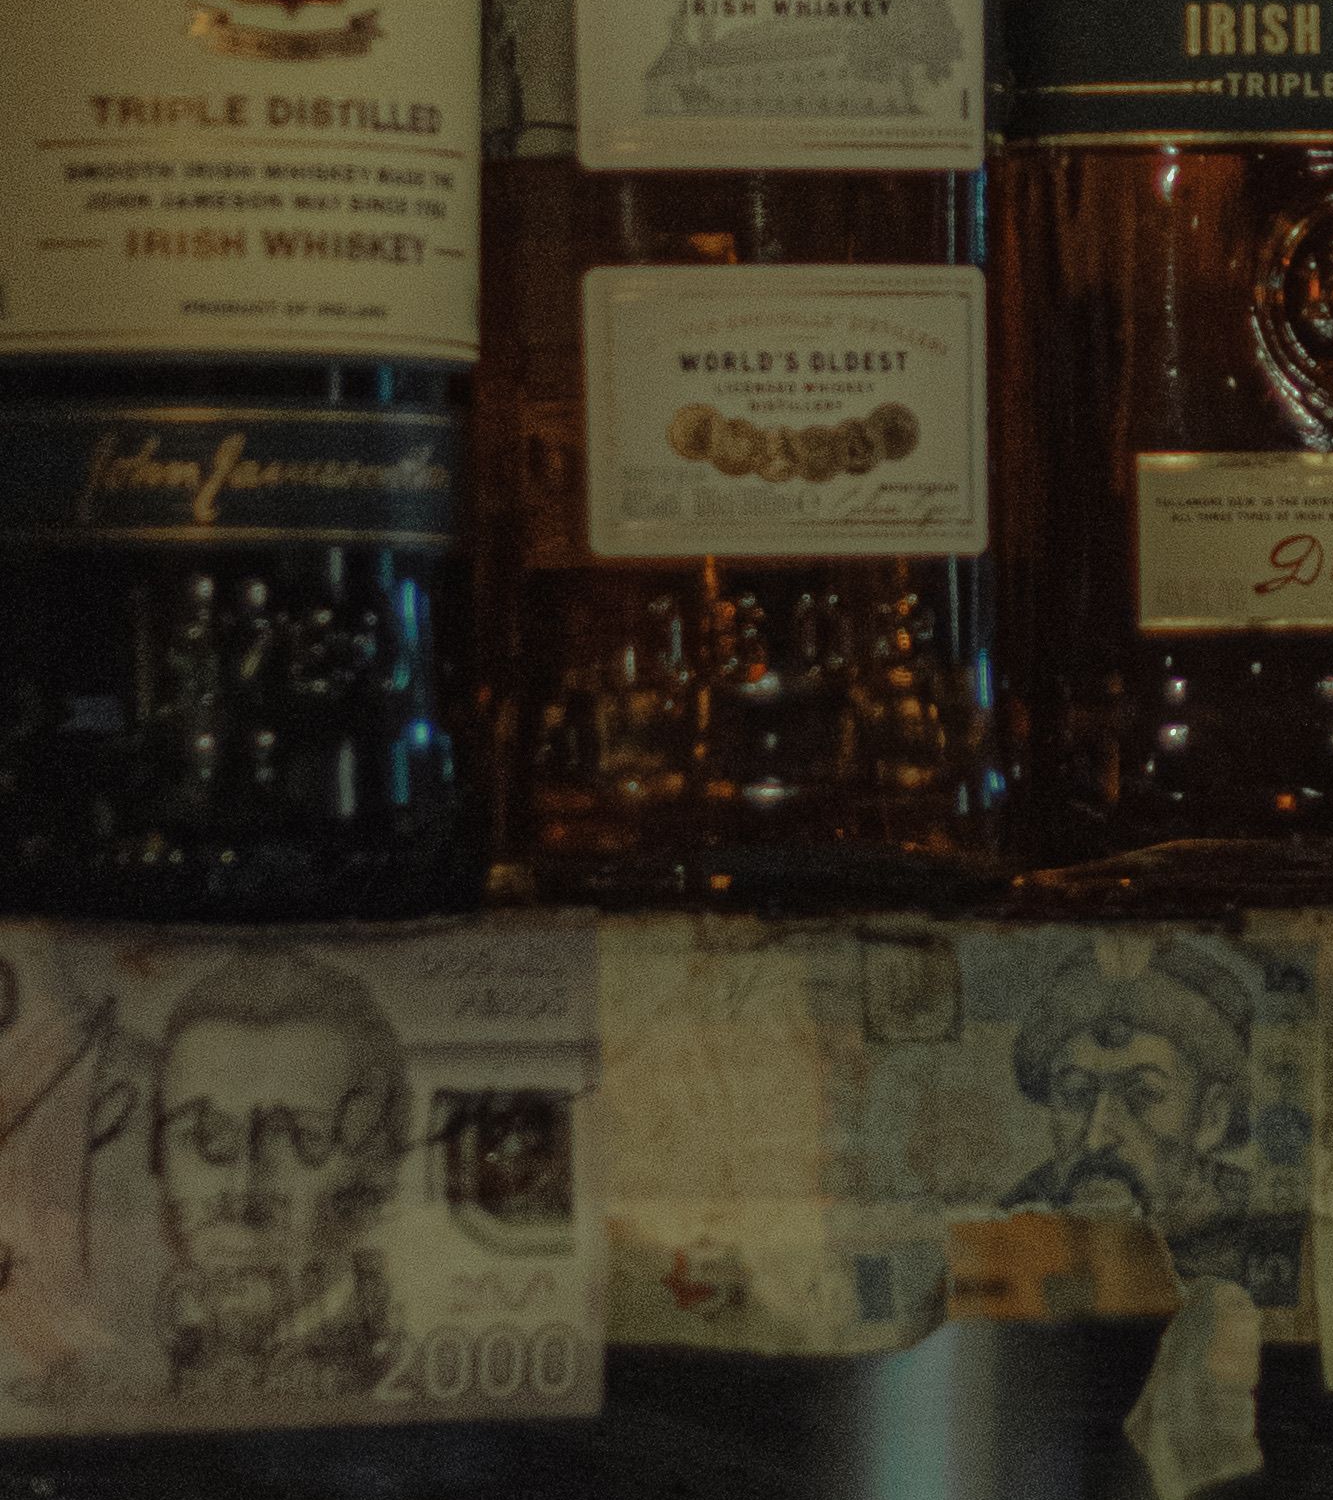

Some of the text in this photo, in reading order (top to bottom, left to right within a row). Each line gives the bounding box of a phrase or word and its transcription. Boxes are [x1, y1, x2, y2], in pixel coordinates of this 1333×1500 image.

[1182, 2, 1324, 58] IRISH
[88, 92, 443, 136] TRIPLE DISTILLED
[124, 226, 430, 266] IRISH WHISKEY
[676, 349, 909, 375] WORLD'S OLDEST
